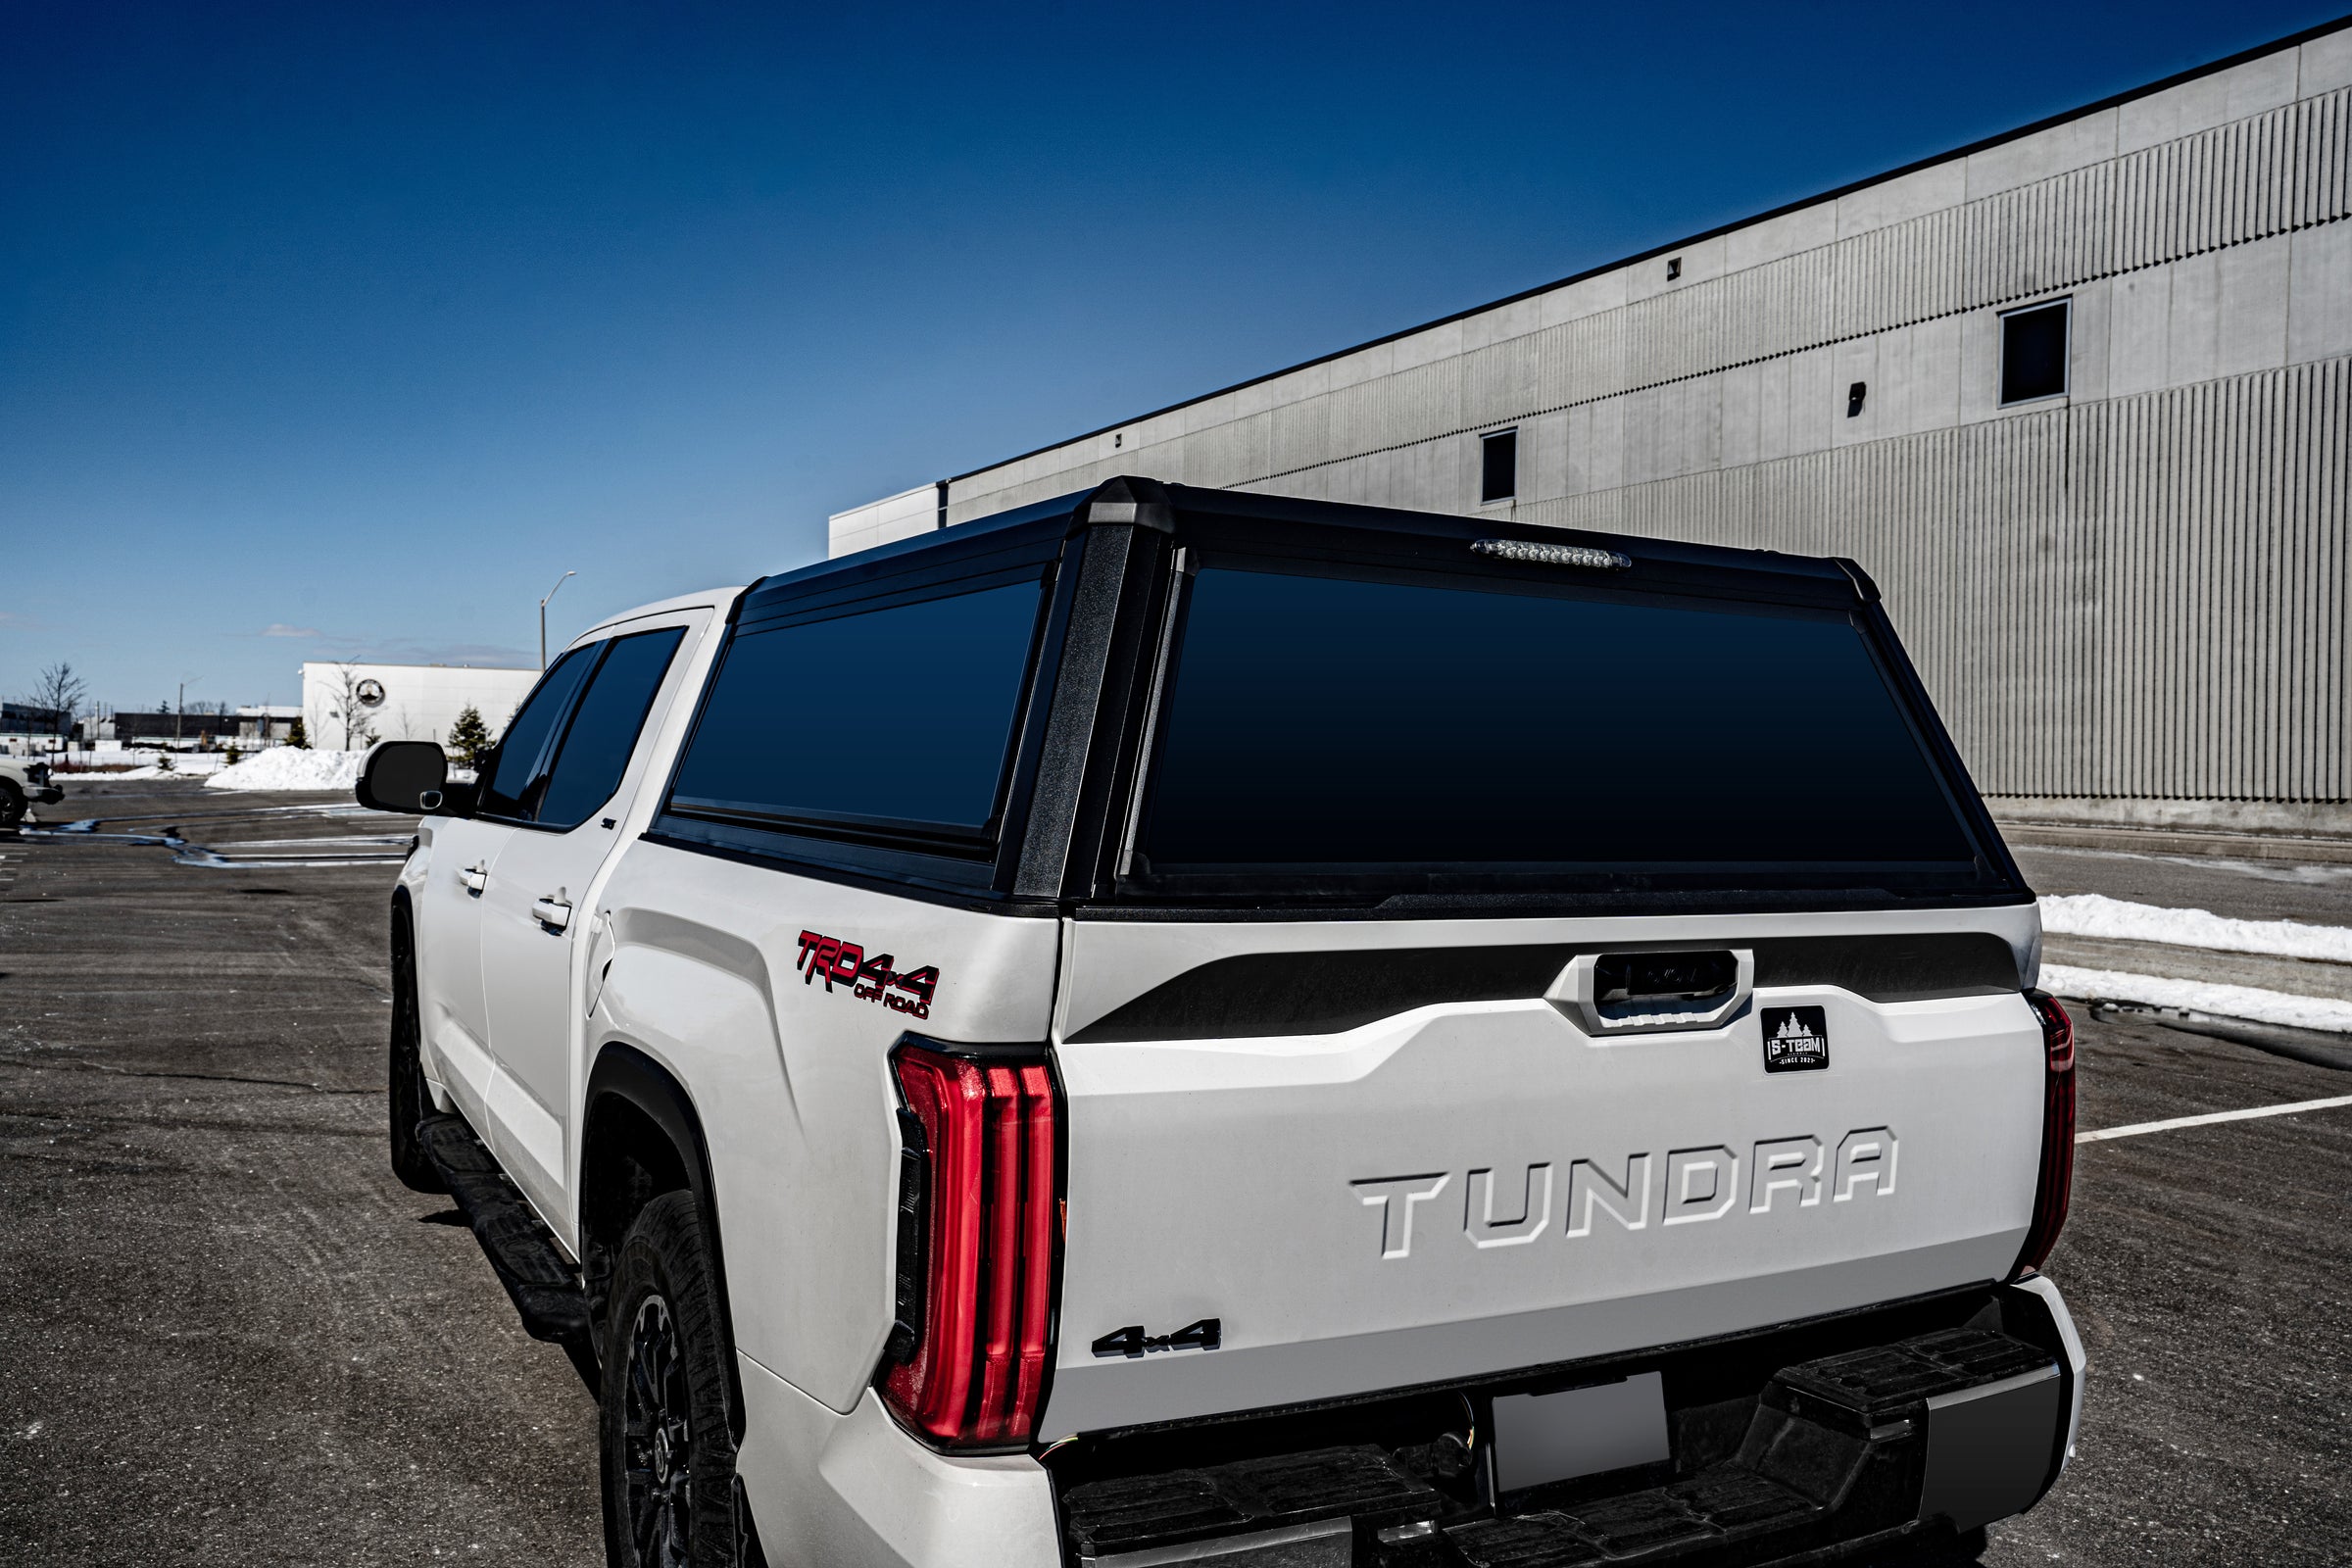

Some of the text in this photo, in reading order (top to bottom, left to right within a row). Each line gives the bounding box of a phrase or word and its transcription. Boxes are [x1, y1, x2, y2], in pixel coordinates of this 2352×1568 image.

[797, 930, 863, 993] TRD
[854, 984, 929, 1020] OFF ROAD
[1348, 1126, 1898, 1259] TUNDRA
